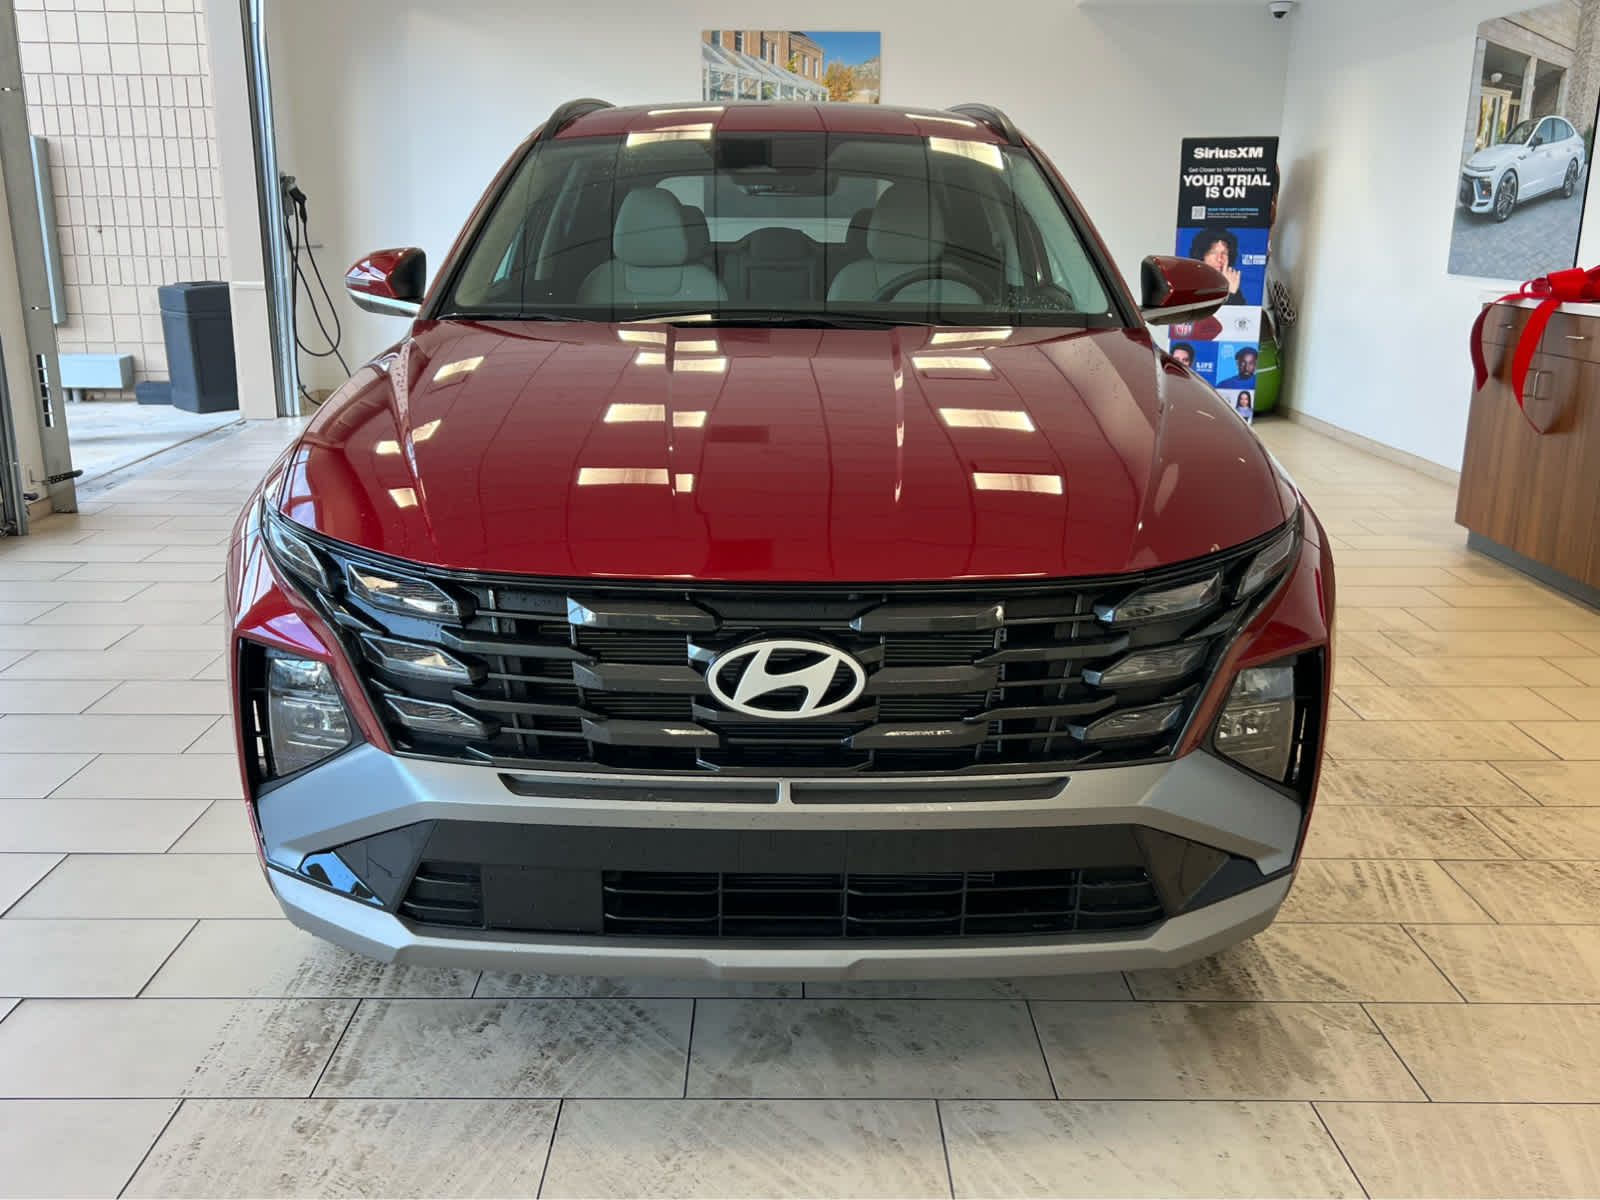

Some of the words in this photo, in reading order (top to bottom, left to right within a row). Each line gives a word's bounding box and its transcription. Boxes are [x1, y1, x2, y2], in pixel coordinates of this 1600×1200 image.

[1193, 147, 1264, 159] SiriusXM
[1183, 174, 1224, 187] YOUR
[1227, 174, 1271, 186] TRIAL
[1205, 186, 1220, 198] IS
[1222, 186, 1246, 198] ON
